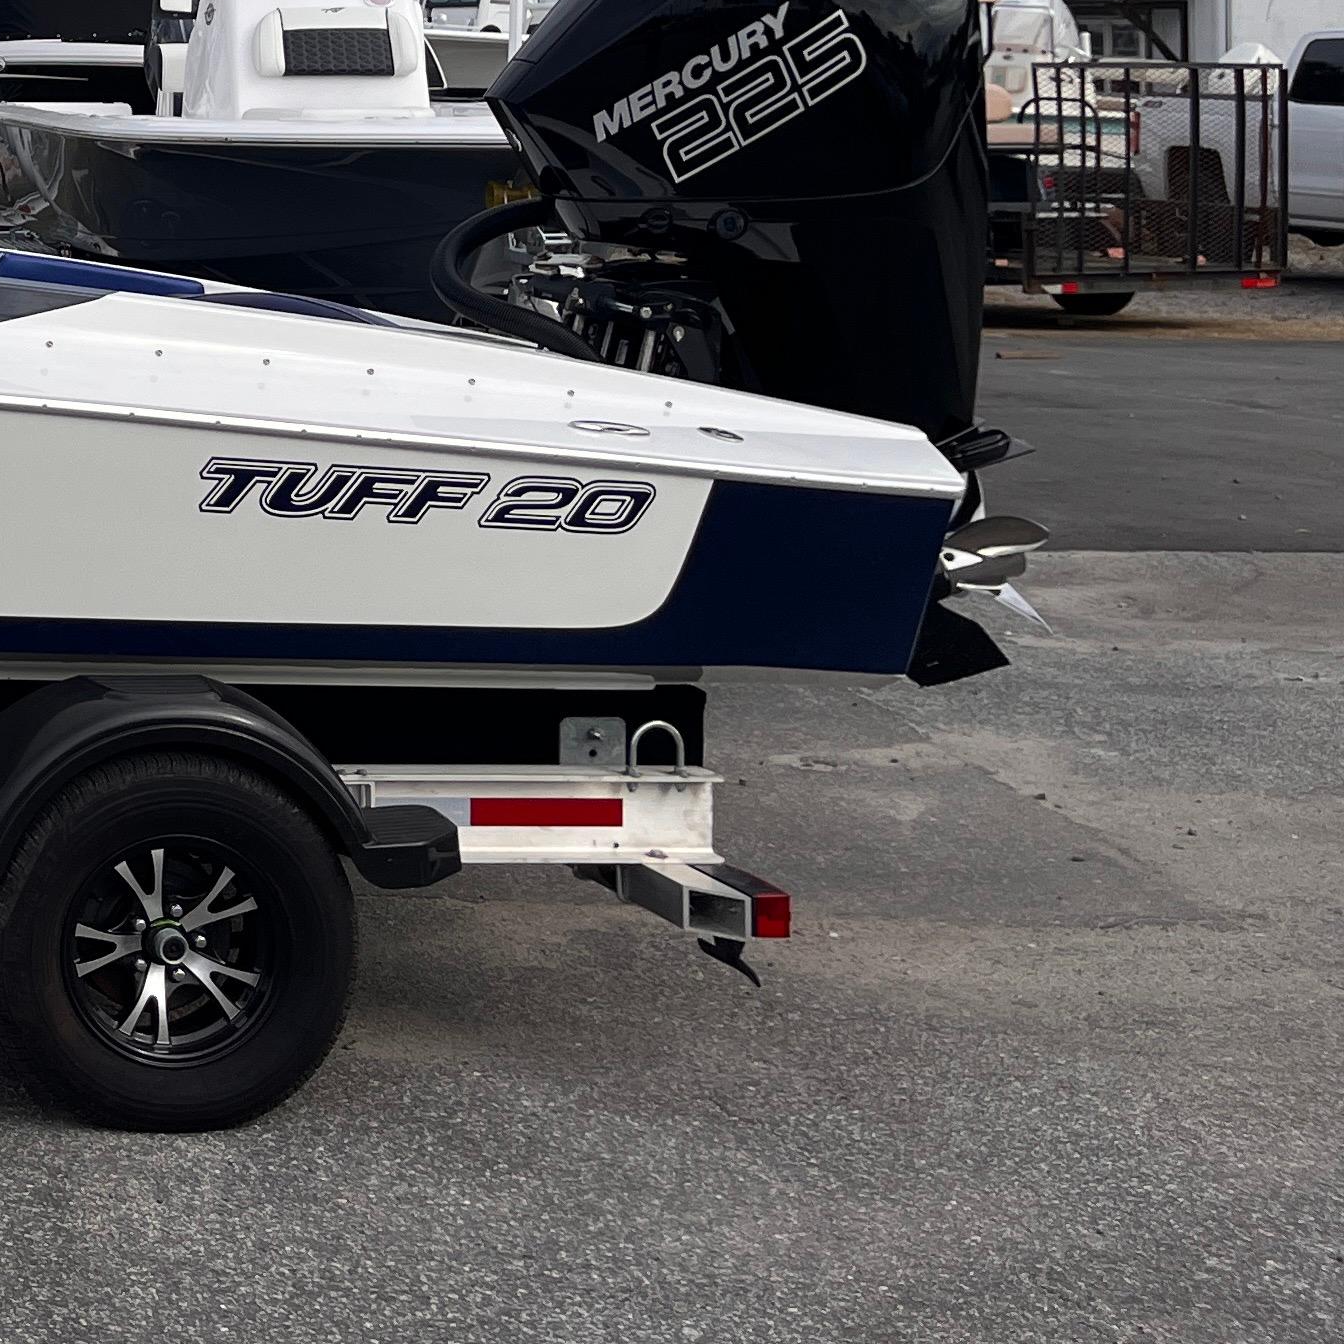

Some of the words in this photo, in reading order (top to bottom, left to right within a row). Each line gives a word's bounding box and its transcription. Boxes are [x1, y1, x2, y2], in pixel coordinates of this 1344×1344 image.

[593, 1, 790, 143] MERCURY
[651, 9, 867, 183] 225
[200, 456, 490, 524] TUFF
[478, 475, 656, 534] 20
